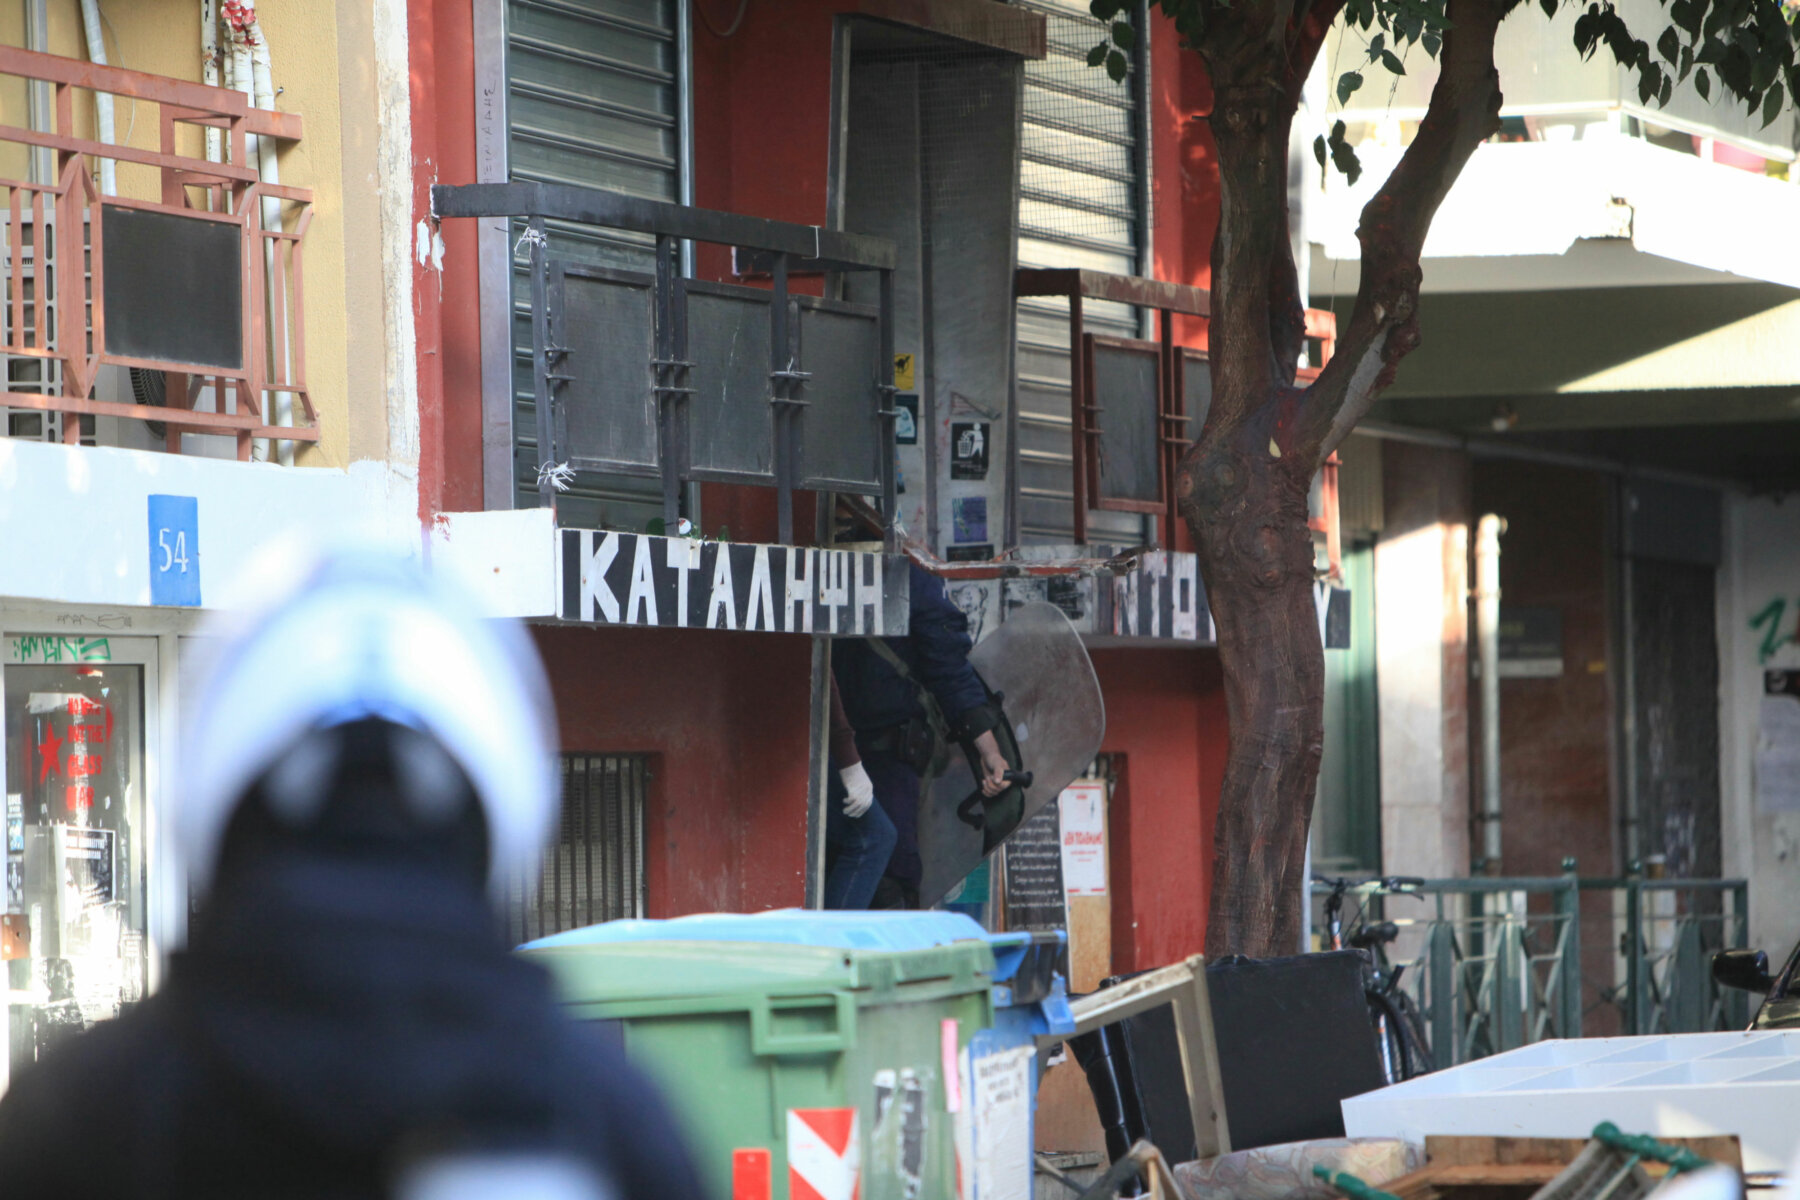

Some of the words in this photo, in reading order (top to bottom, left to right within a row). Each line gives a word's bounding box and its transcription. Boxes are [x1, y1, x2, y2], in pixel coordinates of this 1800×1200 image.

[159, 527, 189, 573] 54
[579, 530, 884, 636] ΚΑΤΑΛΗΨΗ
[86, 725, 104, 744] THE
[67, 754, 102, 777] CLASS
